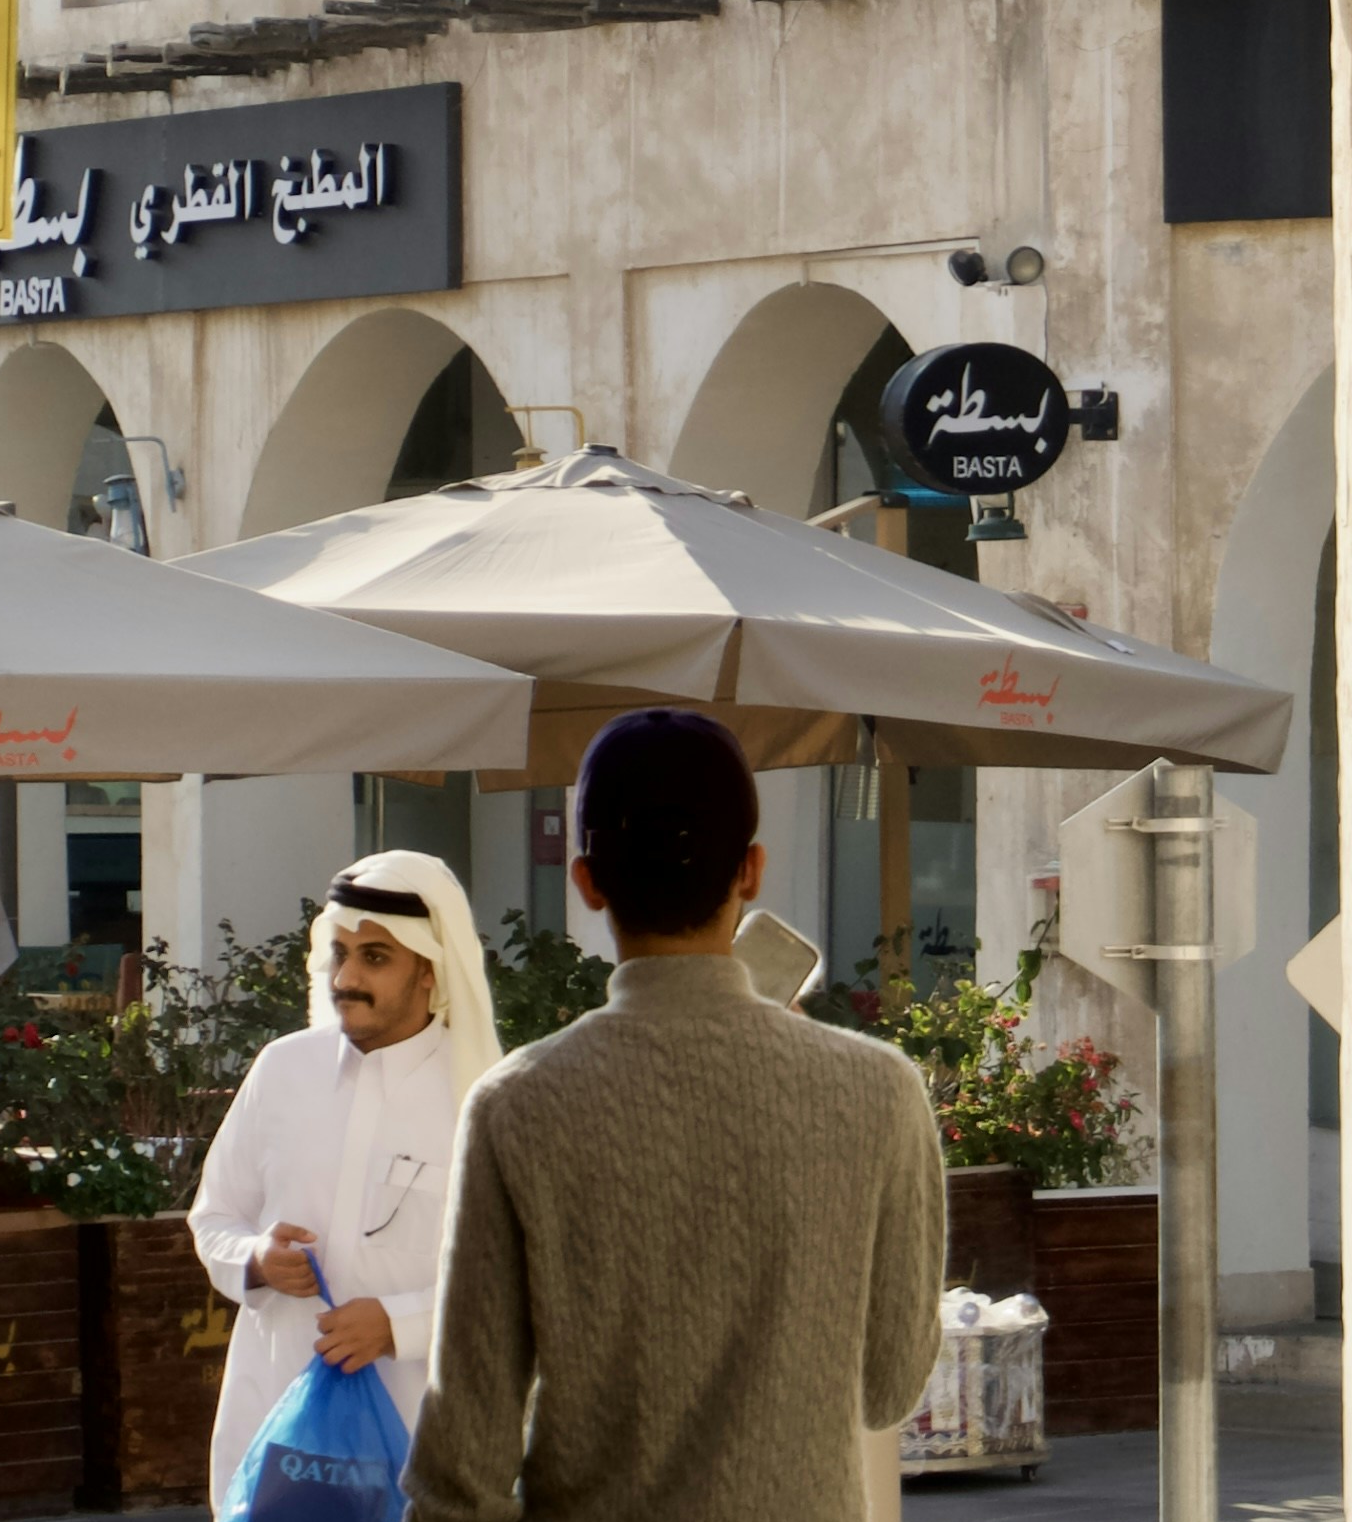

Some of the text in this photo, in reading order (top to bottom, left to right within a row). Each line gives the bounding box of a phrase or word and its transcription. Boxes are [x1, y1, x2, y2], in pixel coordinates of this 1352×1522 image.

[129, 141, 384, 260] المطبخ القطري
[0, 275, 66, 317] BASTA
[925, 361, 1050, 454] بسطة
[952, 455, 1023, 478] BASTA
[976, 649, 1063, 725] بسطة
[279, 1453, 386, 1487] QATA
